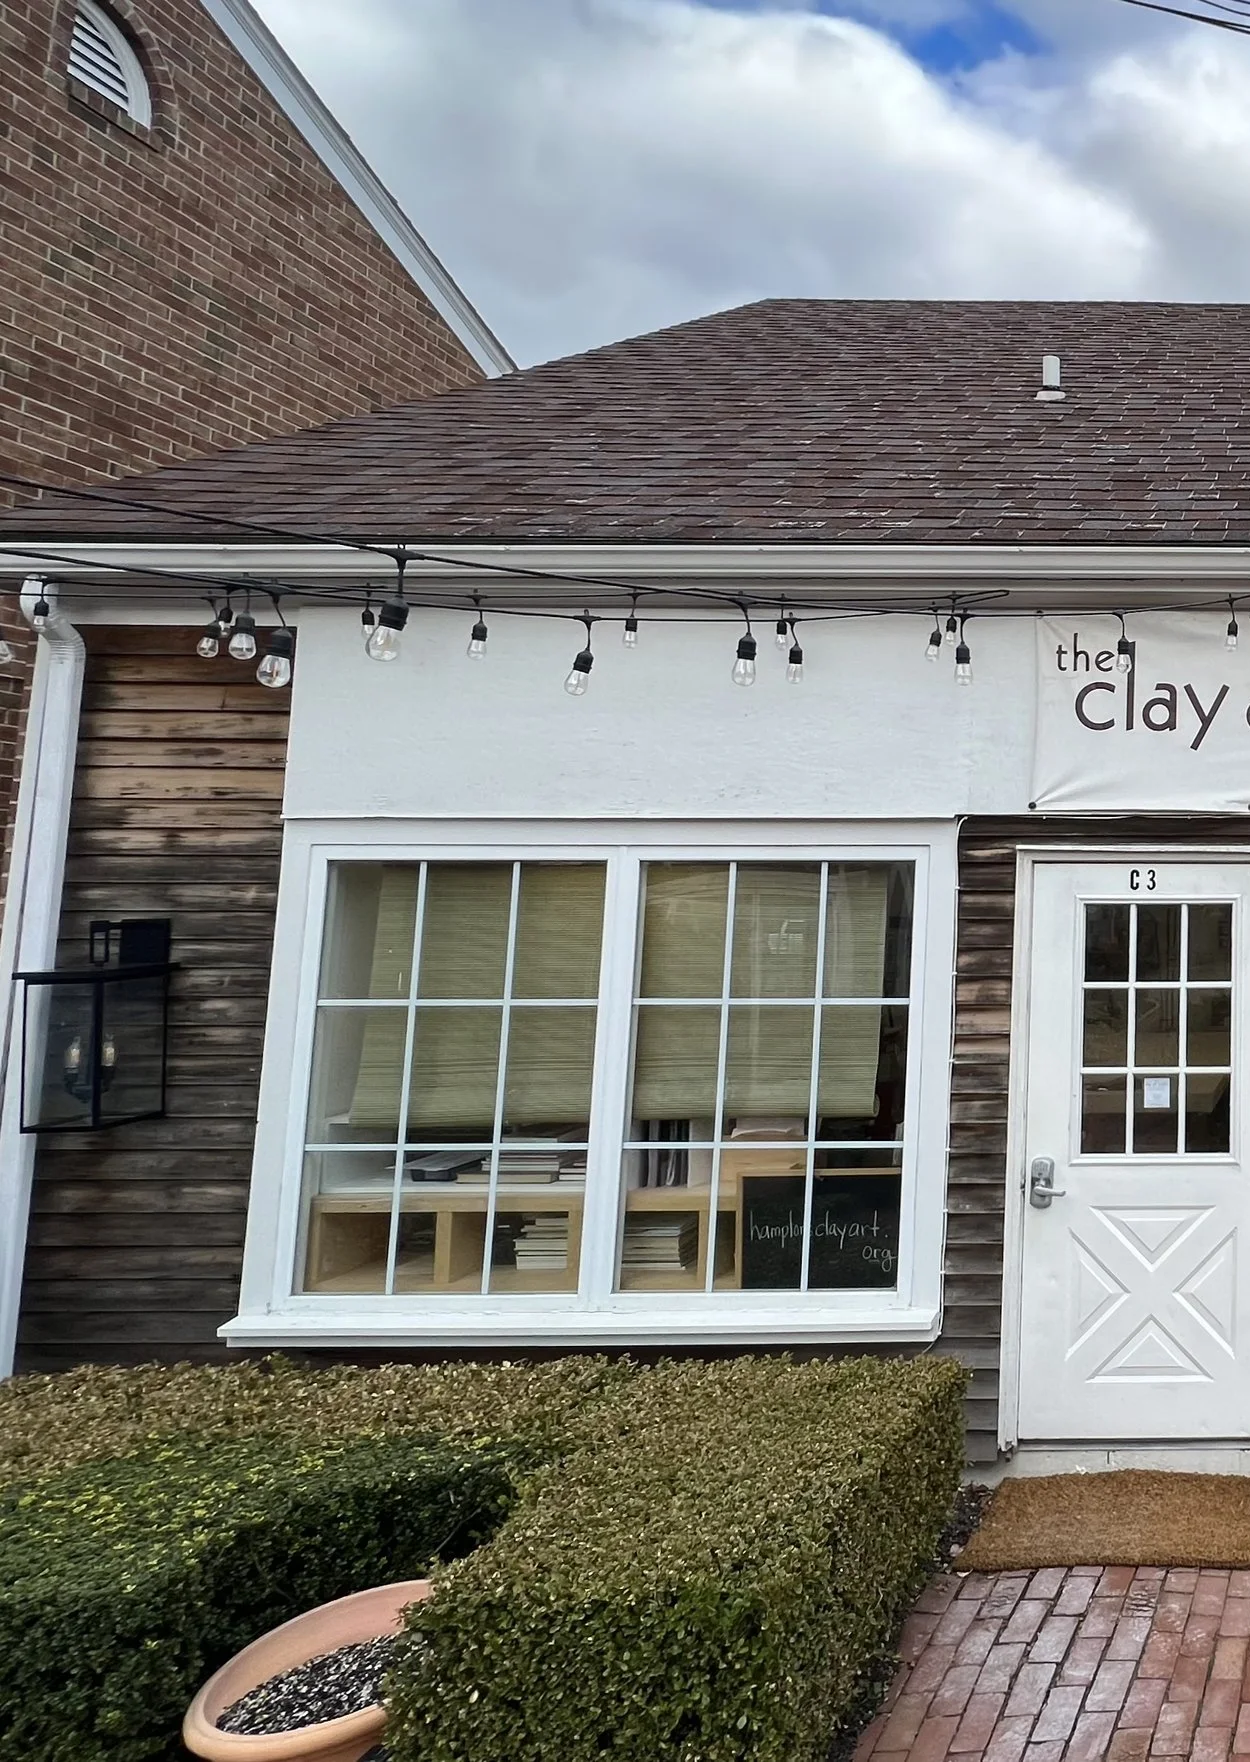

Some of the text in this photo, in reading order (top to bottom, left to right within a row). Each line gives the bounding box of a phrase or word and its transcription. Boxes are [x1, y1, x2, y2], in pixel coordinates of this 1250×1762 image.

[1056, 632, 1115, 672] the
[1075, 640, 1229, 751] clay
[862, 1245, 898, 1273] org
